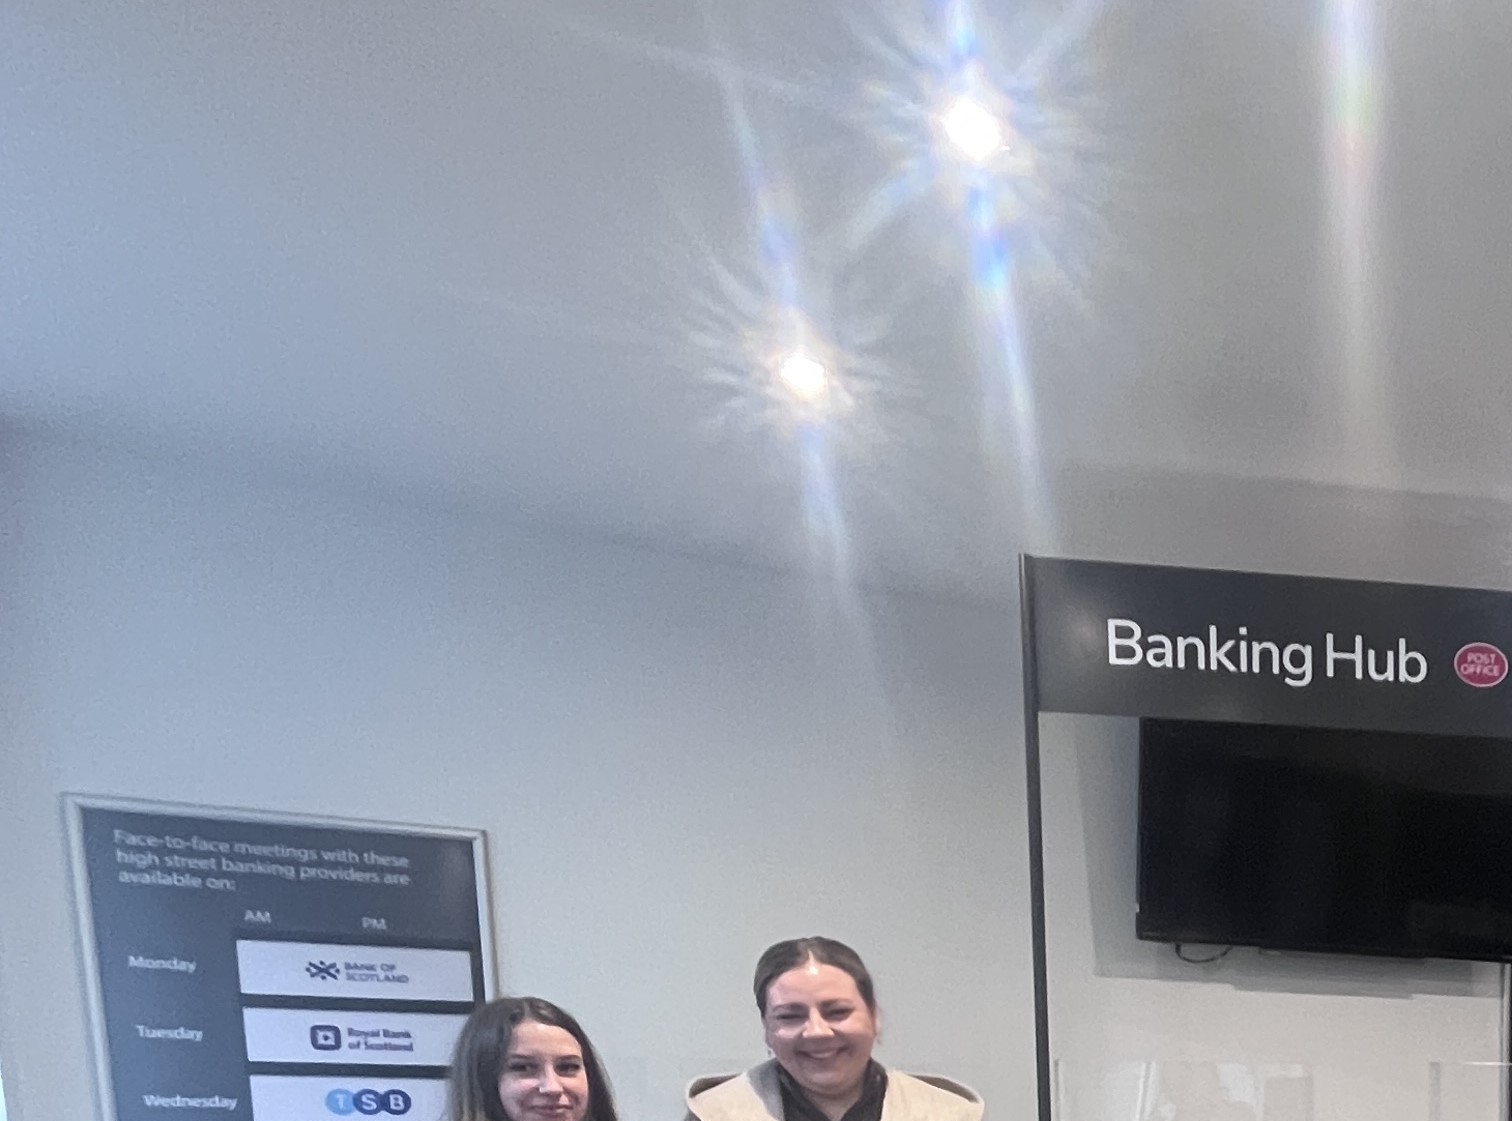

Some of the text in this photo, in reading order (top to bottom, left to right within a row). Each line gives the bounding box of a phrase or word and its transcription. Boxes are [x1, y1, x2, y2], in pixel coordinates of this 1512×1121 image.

[1107, 618, 1427, 686] Banking Hub
[1467, 652, 1496, 664] POST
[1460, 663, 1500, 677] OFFICE
[113, 829, 410, 868] Face-to-face meetings with these
[116, 848, 411, 886] high street banking providers are
[118, 870, 203, 888] available
[244, 909, 387, 930] AM PM
[128, 955, 197, 974] Monday
[135, 1024, 203, 1042] Tuesday
[143, 1094, 238, 1111] Wednesday
[331, 1091, 408, 1112] TSB
